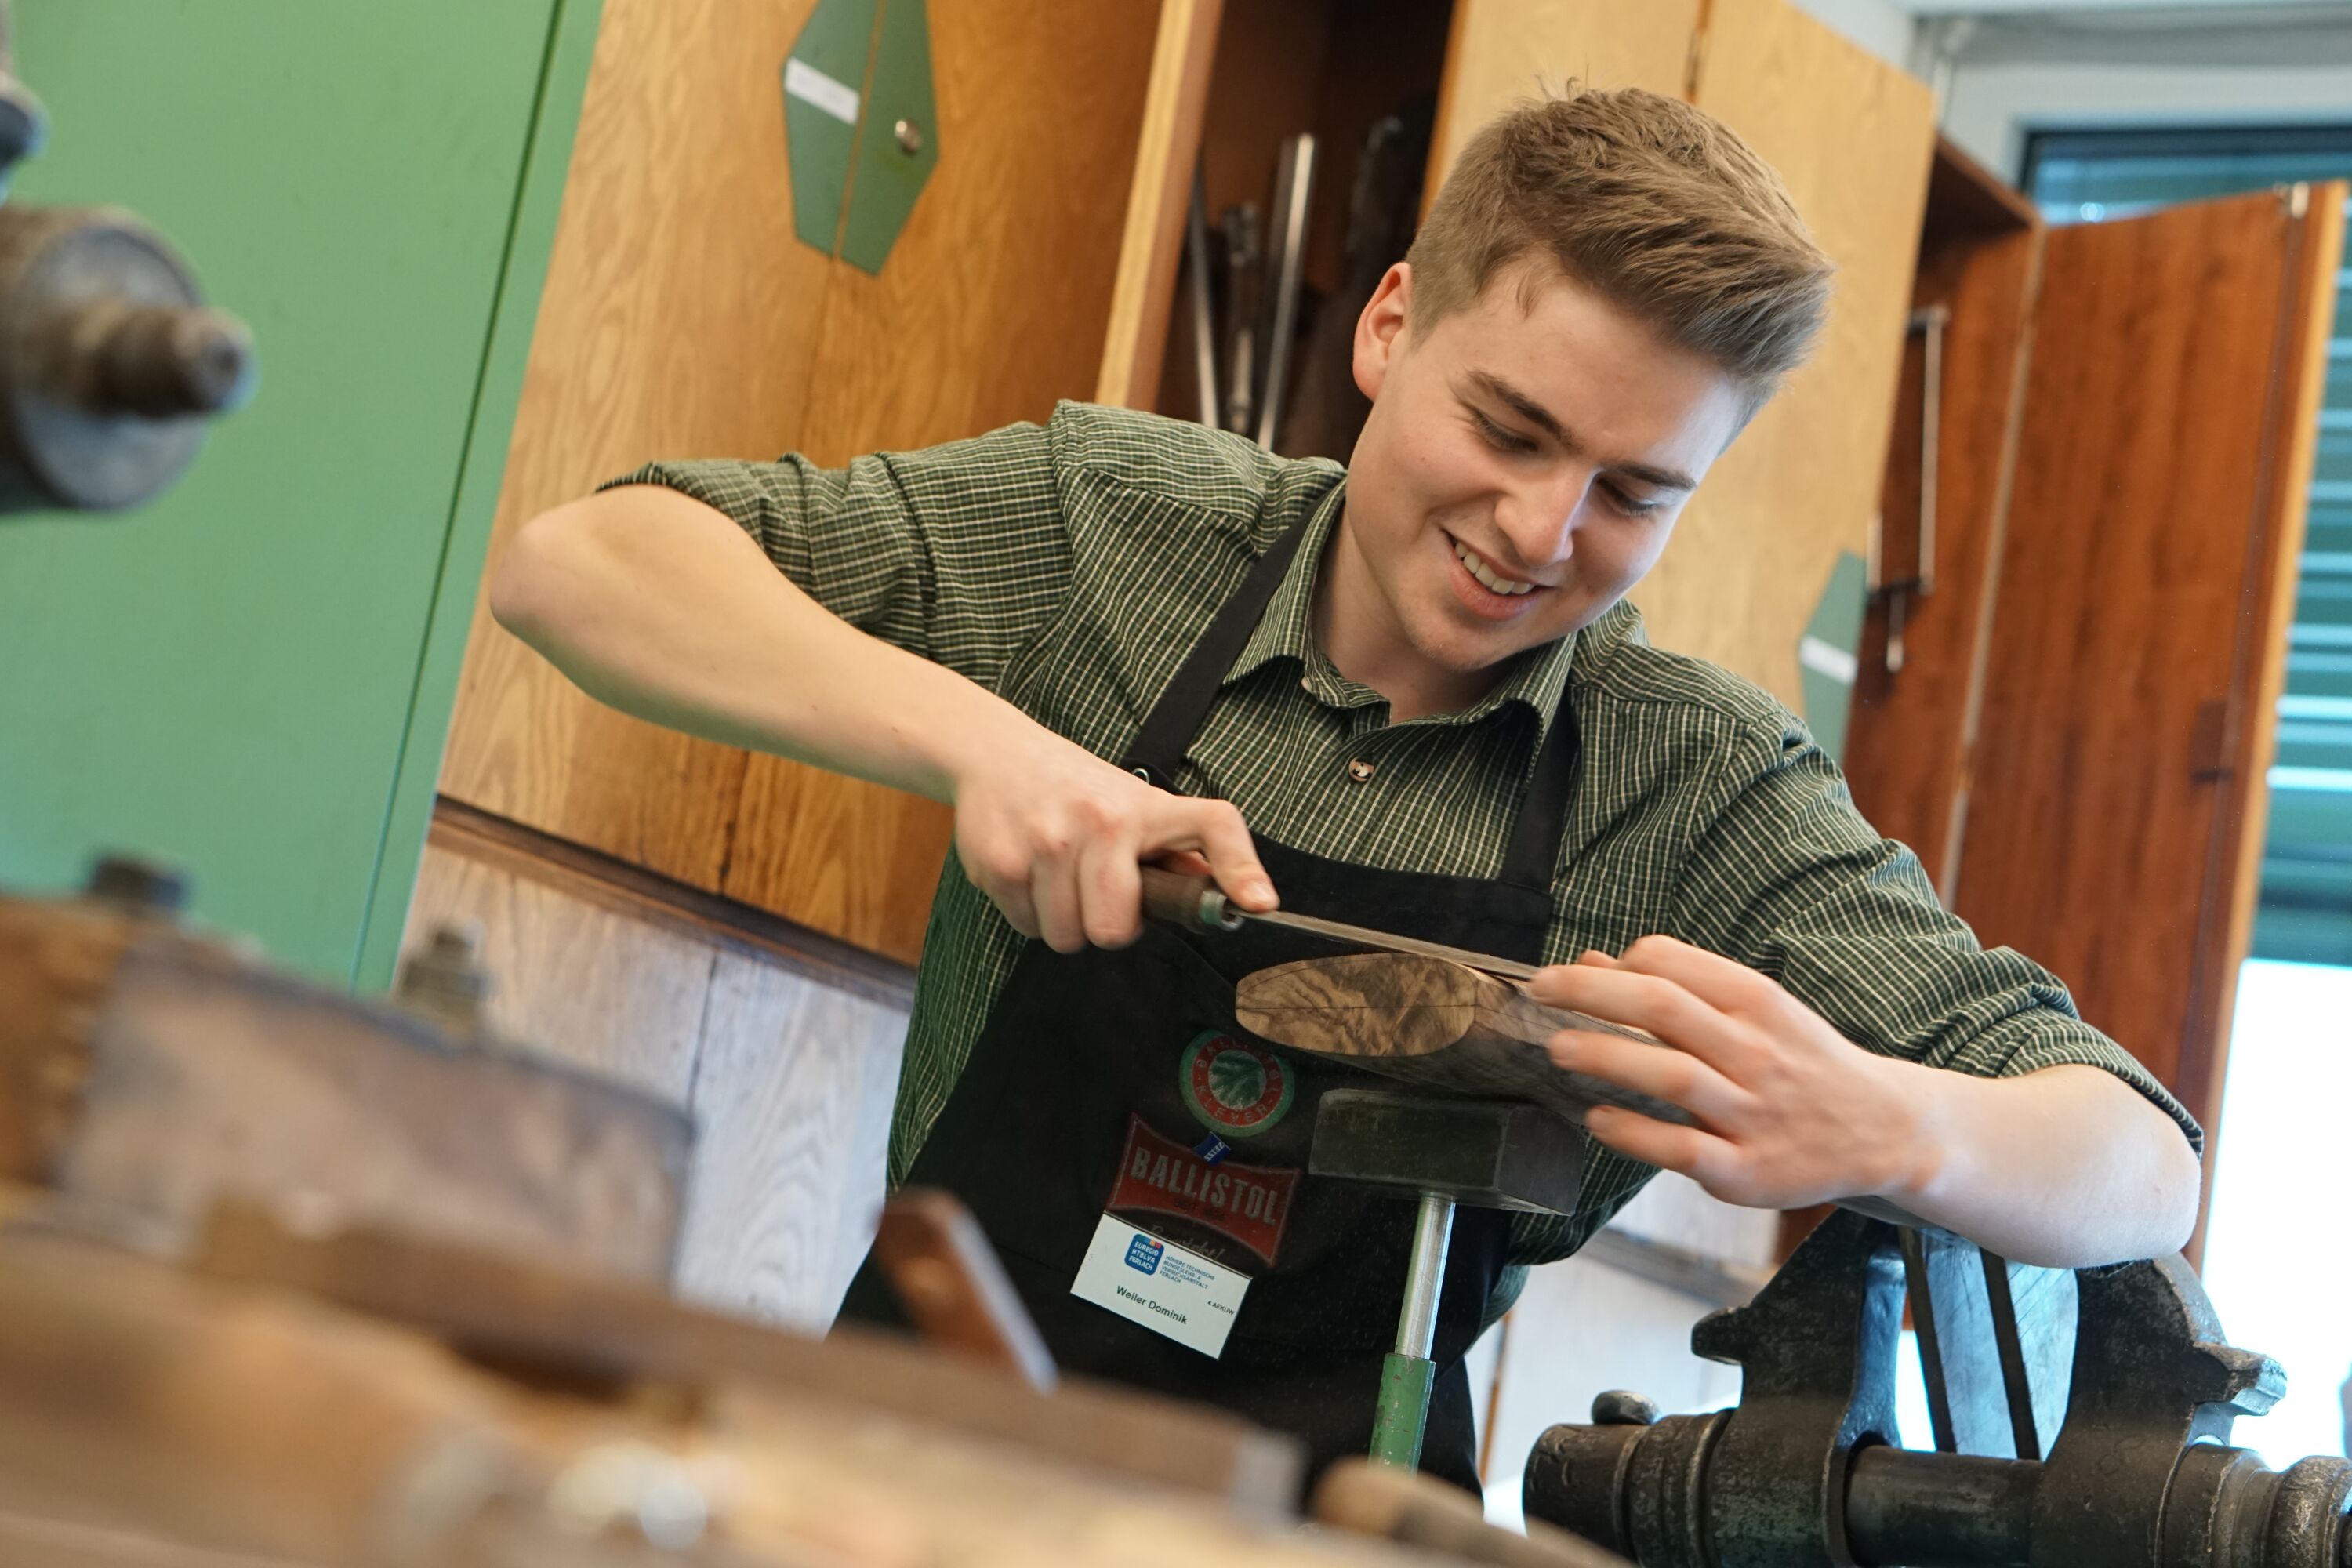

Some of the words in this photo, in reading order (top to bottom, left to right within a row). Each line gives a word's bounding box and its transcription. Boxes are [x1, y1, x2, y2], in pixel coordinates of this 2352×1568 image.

[1203, 1141, 1225, 1163] ZEISS
[1131, 1145, 1279, 1226] BALLISTOL
[1131, 1248, 1156, 1264] HTBLVA
[1134, 1241, 1160, 1257] EUREGIO
[1129, 1255, 1154, 1271] FERLACH
[1186, 1263, 1215, 1281] TECHNISCHE
[1159, 1270, 1182, 1283] FERLACH
[1161, 1265, 1209, 1290] VERSUCHSANSTALT
[1116, 1285, 1147, 1306] Weiler
[1148, 1300, 1189, 1325] Dominik
